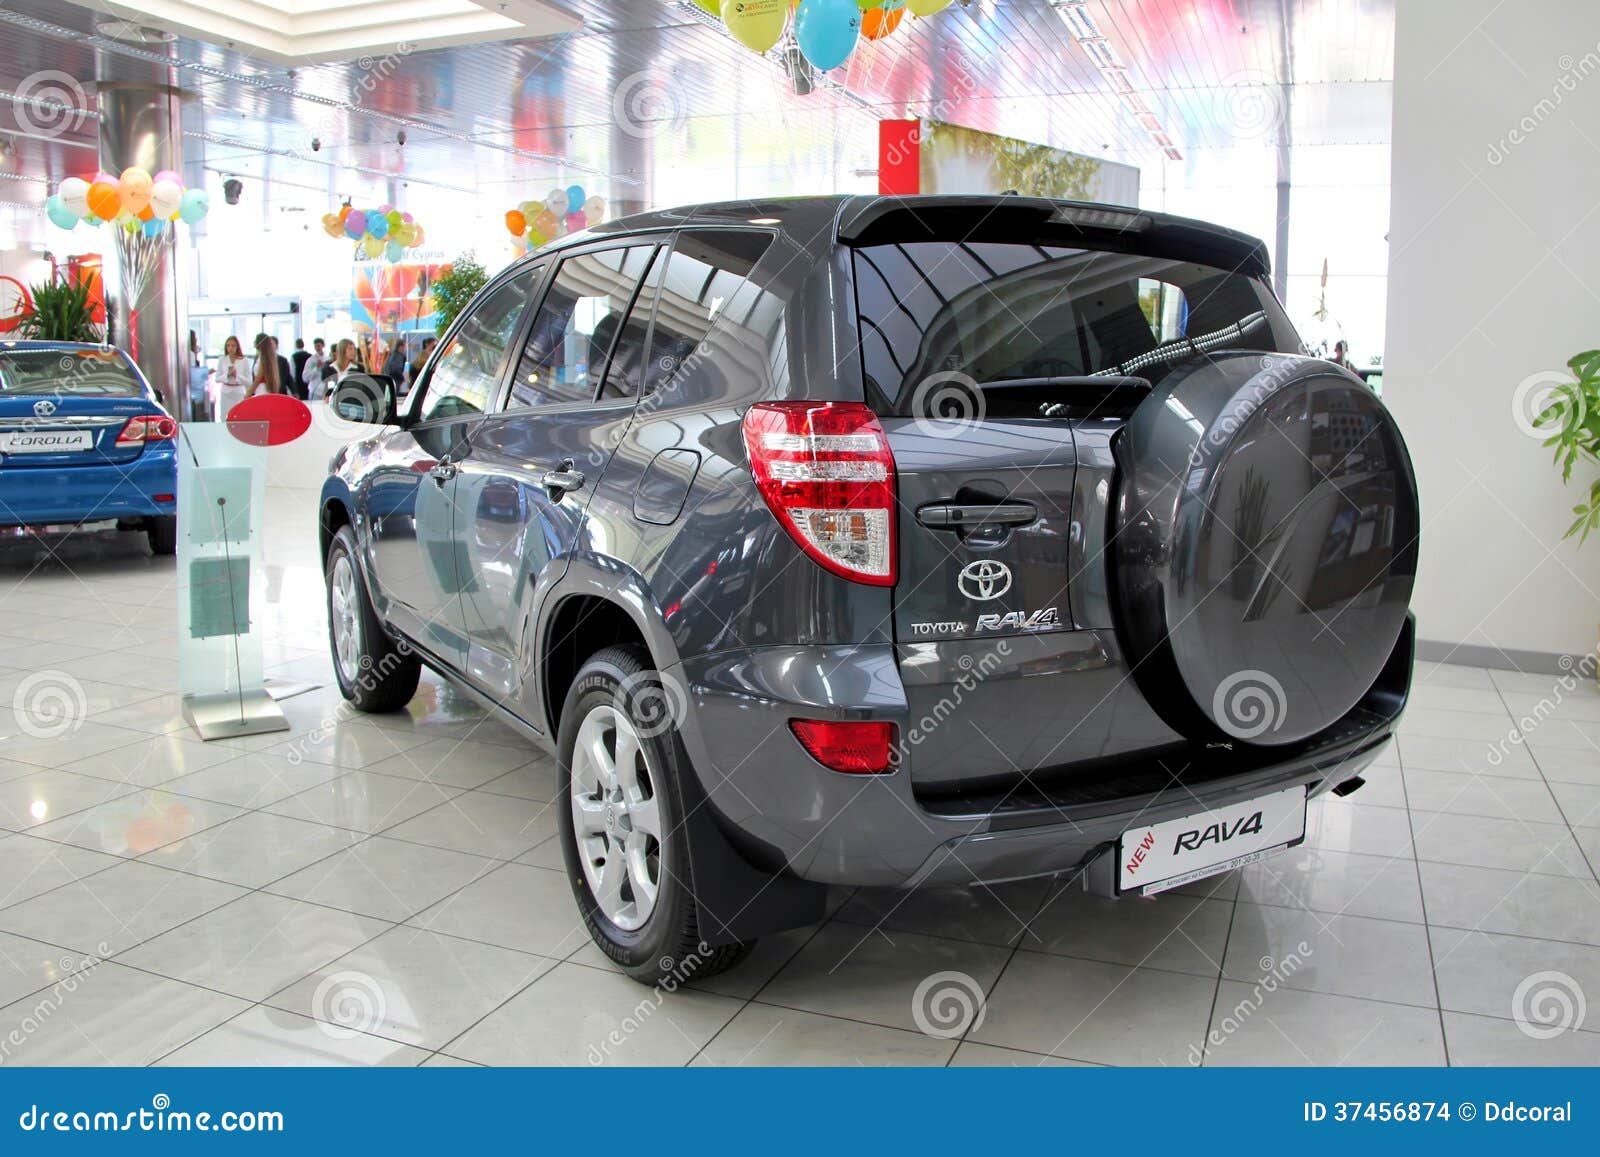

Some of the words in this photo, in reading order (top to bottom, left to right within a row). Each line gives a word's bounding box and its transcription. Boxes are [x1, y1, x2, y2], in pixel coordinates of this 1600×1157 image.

[910, 621, 966, 635] TOYOTA
[975, 607, 1059, 632] RAV4
[1126, 831, 1156, 875] NEW
[1173, 811, 1263, 856] RAV4
